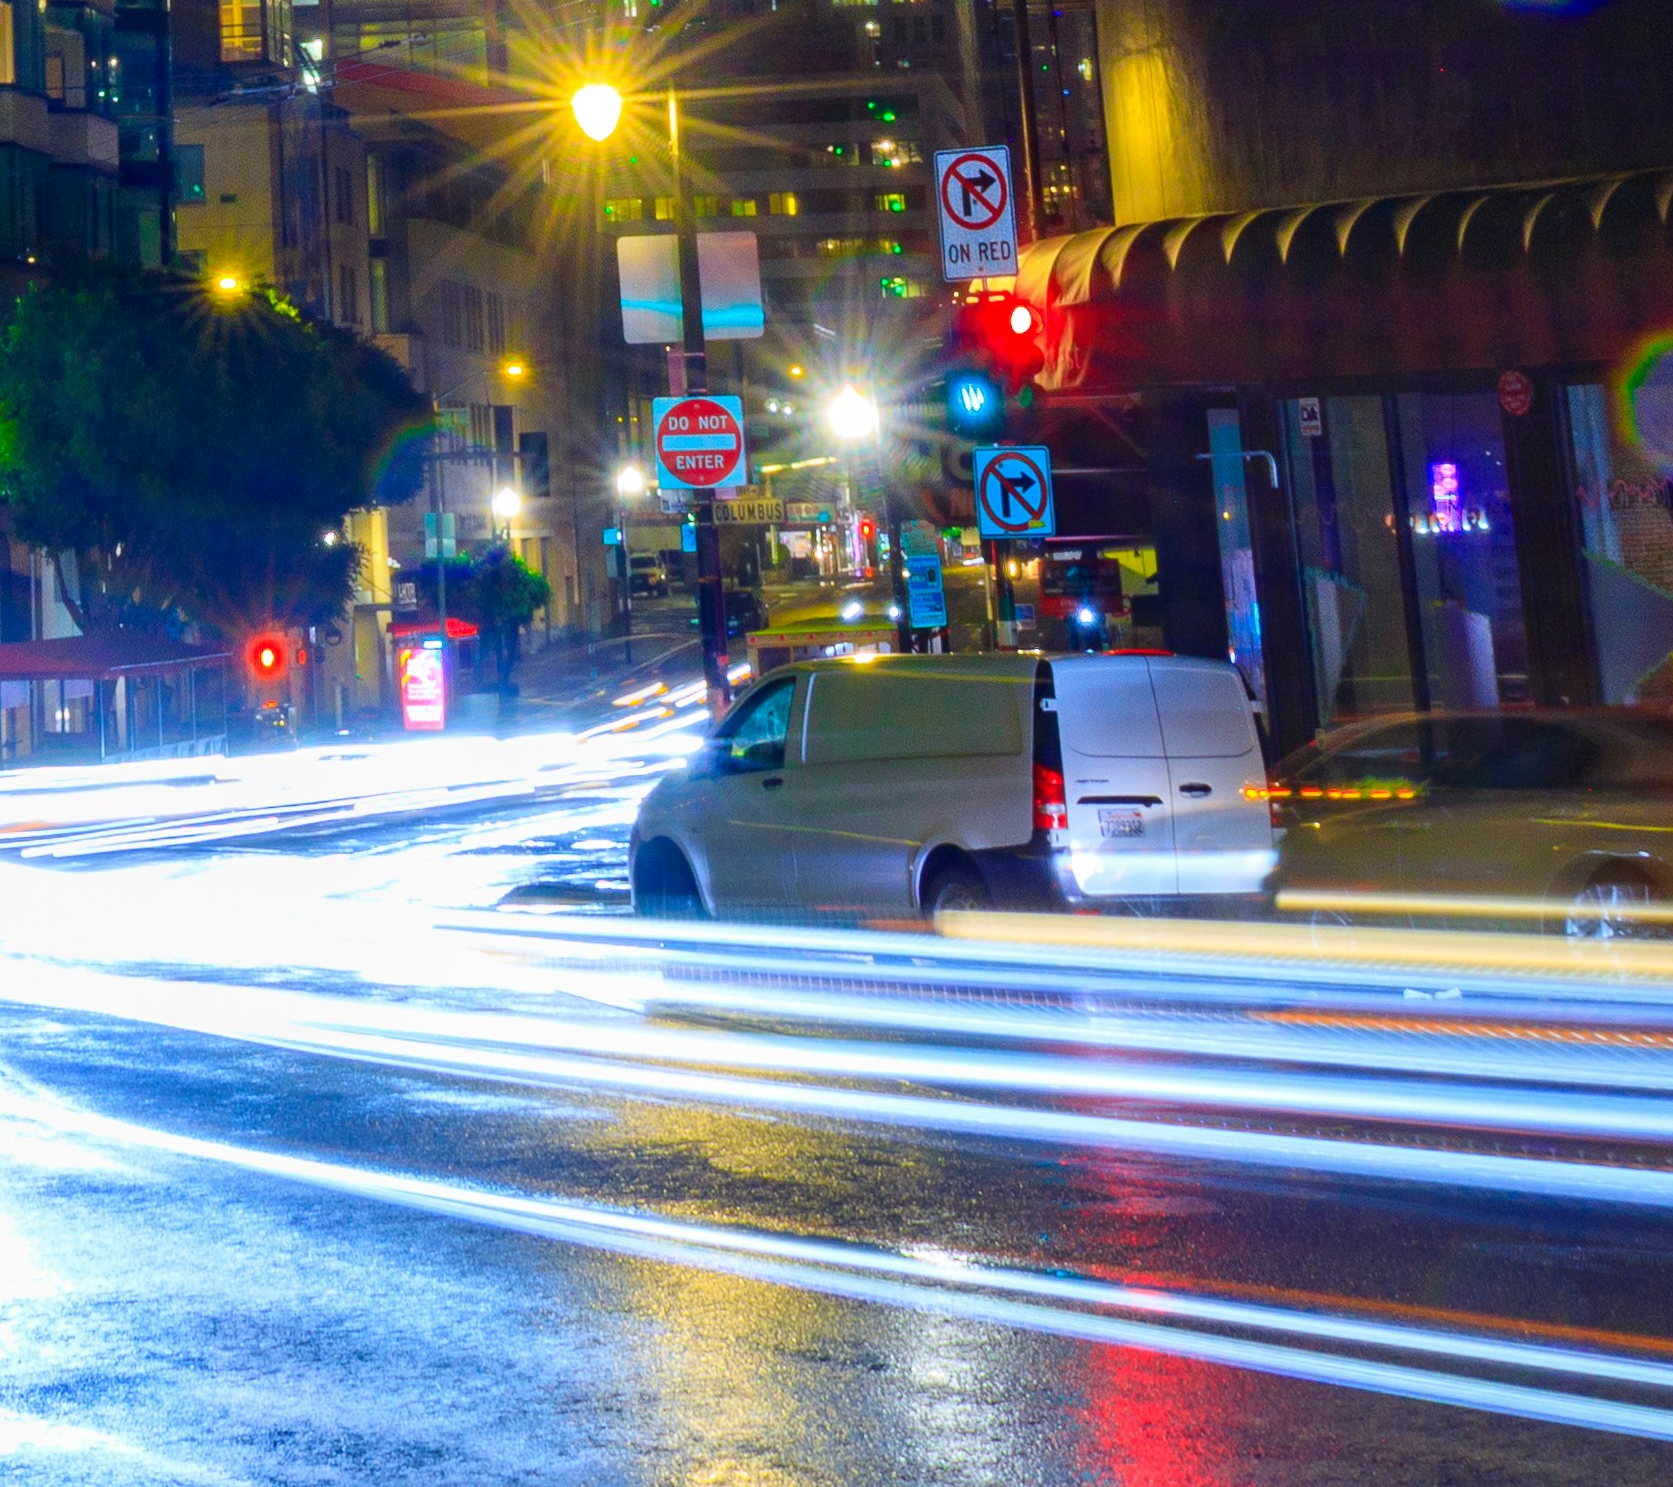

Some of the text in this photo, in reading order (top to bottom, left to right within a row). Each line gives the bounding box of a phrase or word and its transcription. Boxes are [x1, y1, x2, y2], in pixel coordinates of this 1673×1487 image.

[949, 240, 1012, 264] ON RED
[667, 414, 729, 431] DO NOT
[675, 454, 725, 470] ENTER
[714, 502, 784, 525] COLUMBUS
